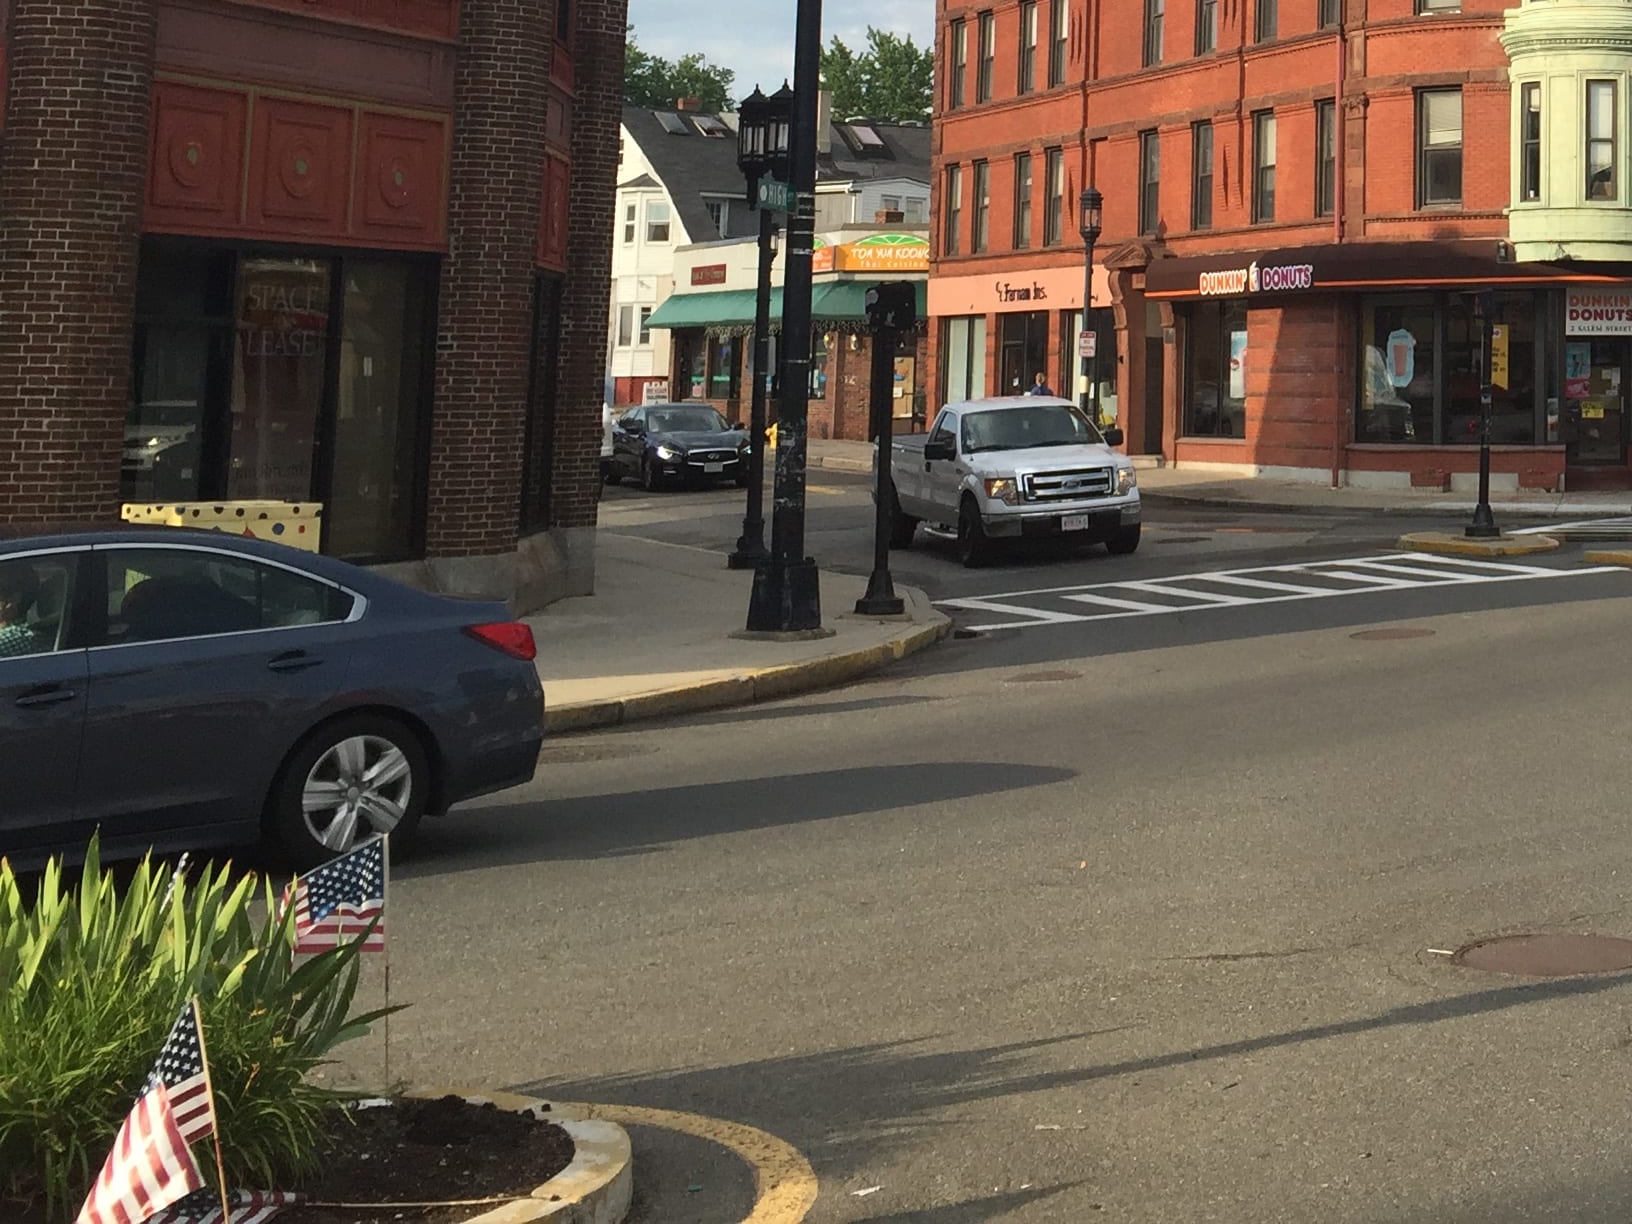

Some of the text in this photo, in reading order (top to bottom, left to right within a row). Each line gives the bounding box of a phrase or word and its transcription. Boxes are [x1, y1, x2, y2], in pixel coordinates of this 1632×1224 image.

[769, 184, 787, 206] HIGH
[1263, 264, 1313, 291] DONUTS
[248, 283, 320, 313] SPACE
[247, 329, 315, 357] LEASE
